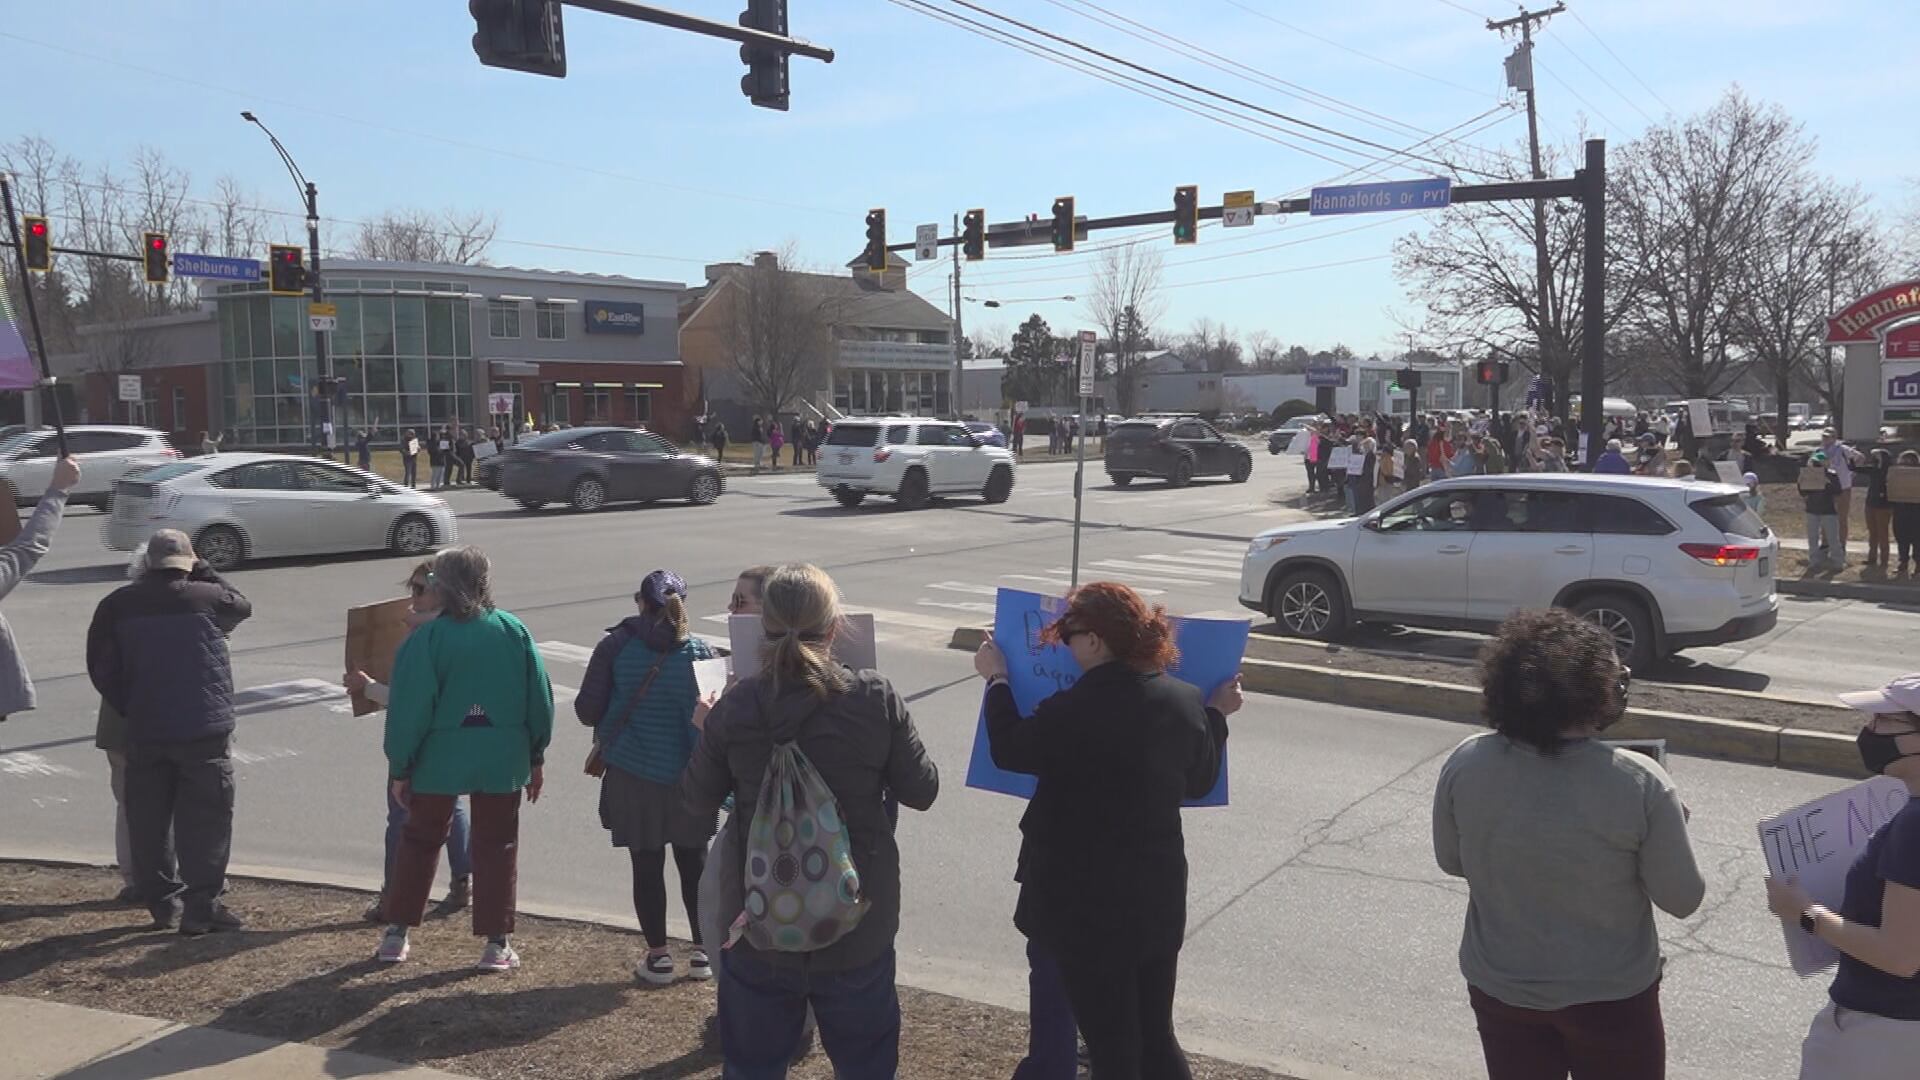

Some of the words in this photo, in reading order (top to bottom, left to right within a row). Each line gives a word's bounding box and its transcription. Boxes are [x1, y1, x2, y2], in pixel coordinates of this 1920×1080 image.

[1313, 189, 1392, 210] Hannafords
[1423, 190, 1446, 202] PVT
[176, 258, 238, 276] Shelburne
[244, 268, 257, 277] Rd
[1765, 809, 1835, 873] THE
